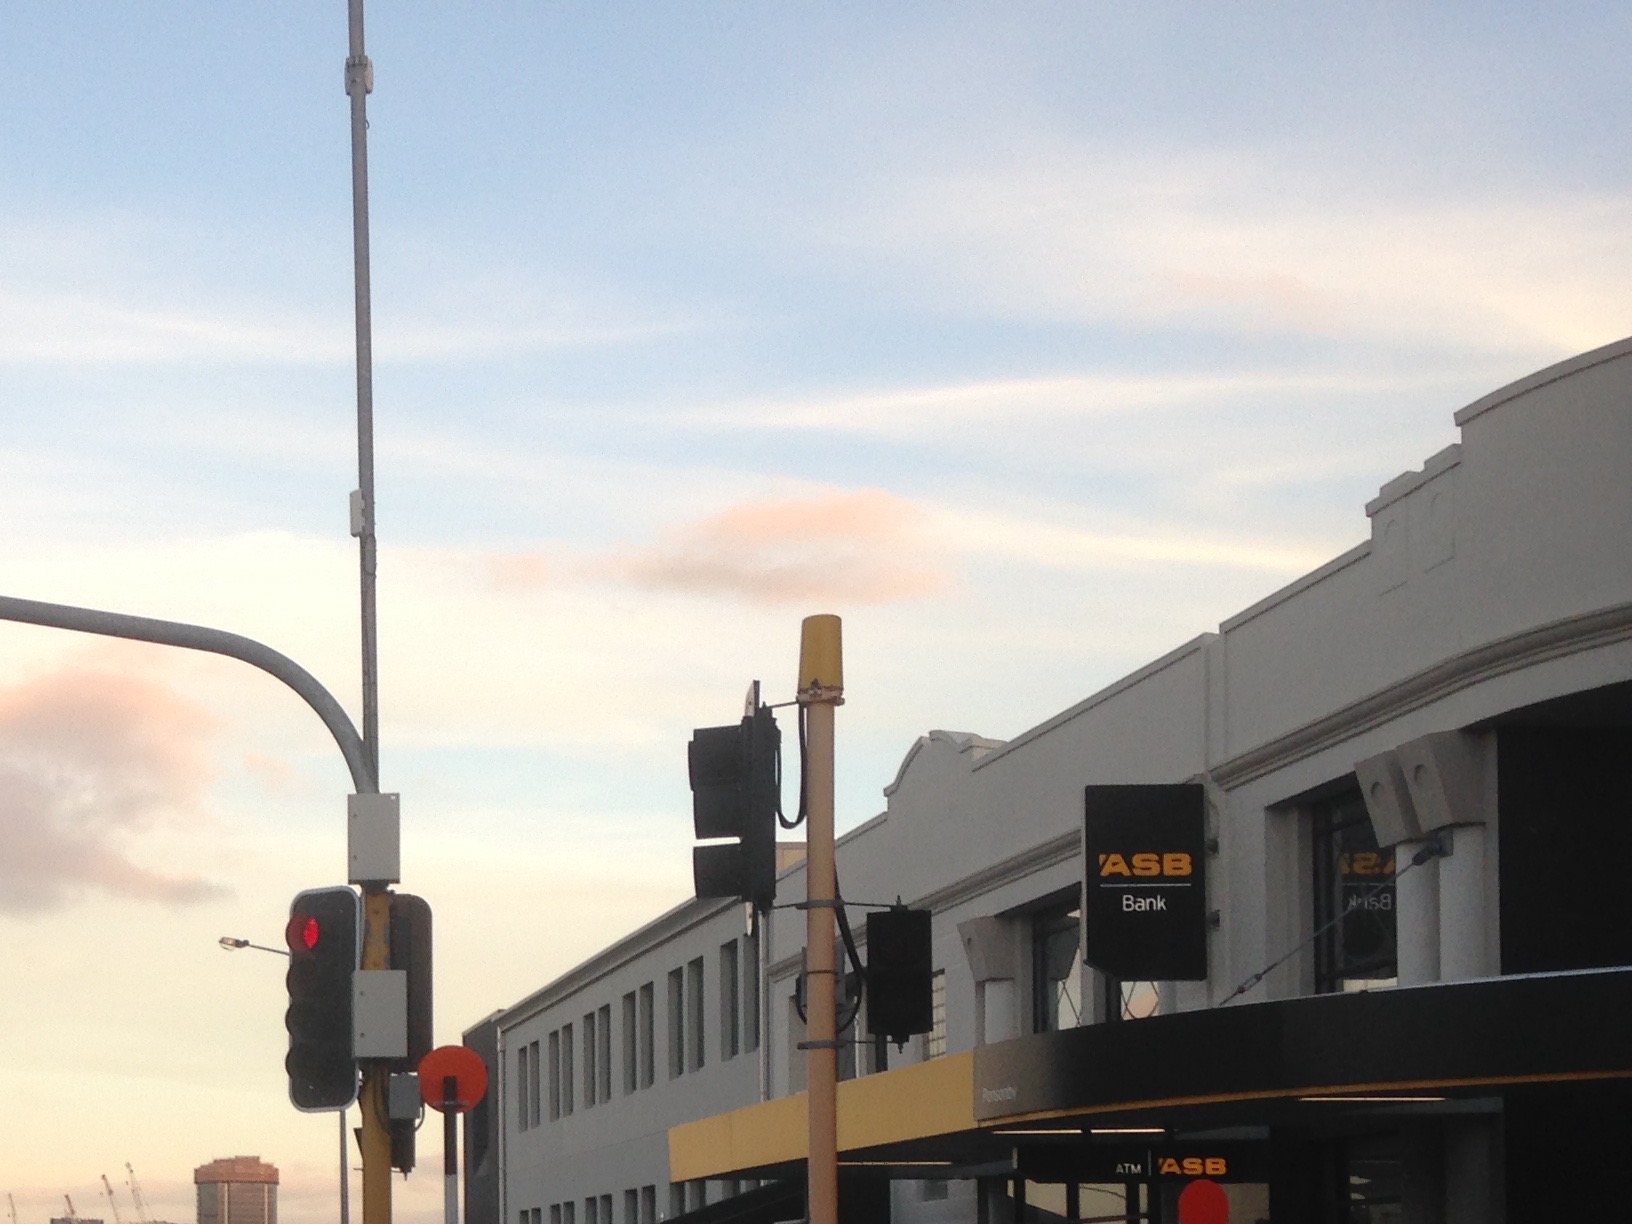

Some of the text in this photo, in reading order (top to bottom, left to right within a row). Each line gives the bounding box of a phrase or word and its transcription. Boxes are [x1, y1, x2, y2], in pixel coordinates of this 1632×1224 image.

[1099, 853, 1192, 876] ASB
[1122, 894, 1167, 911] Bank
[1115, 1157, 1226, 1175] ATM ASB
